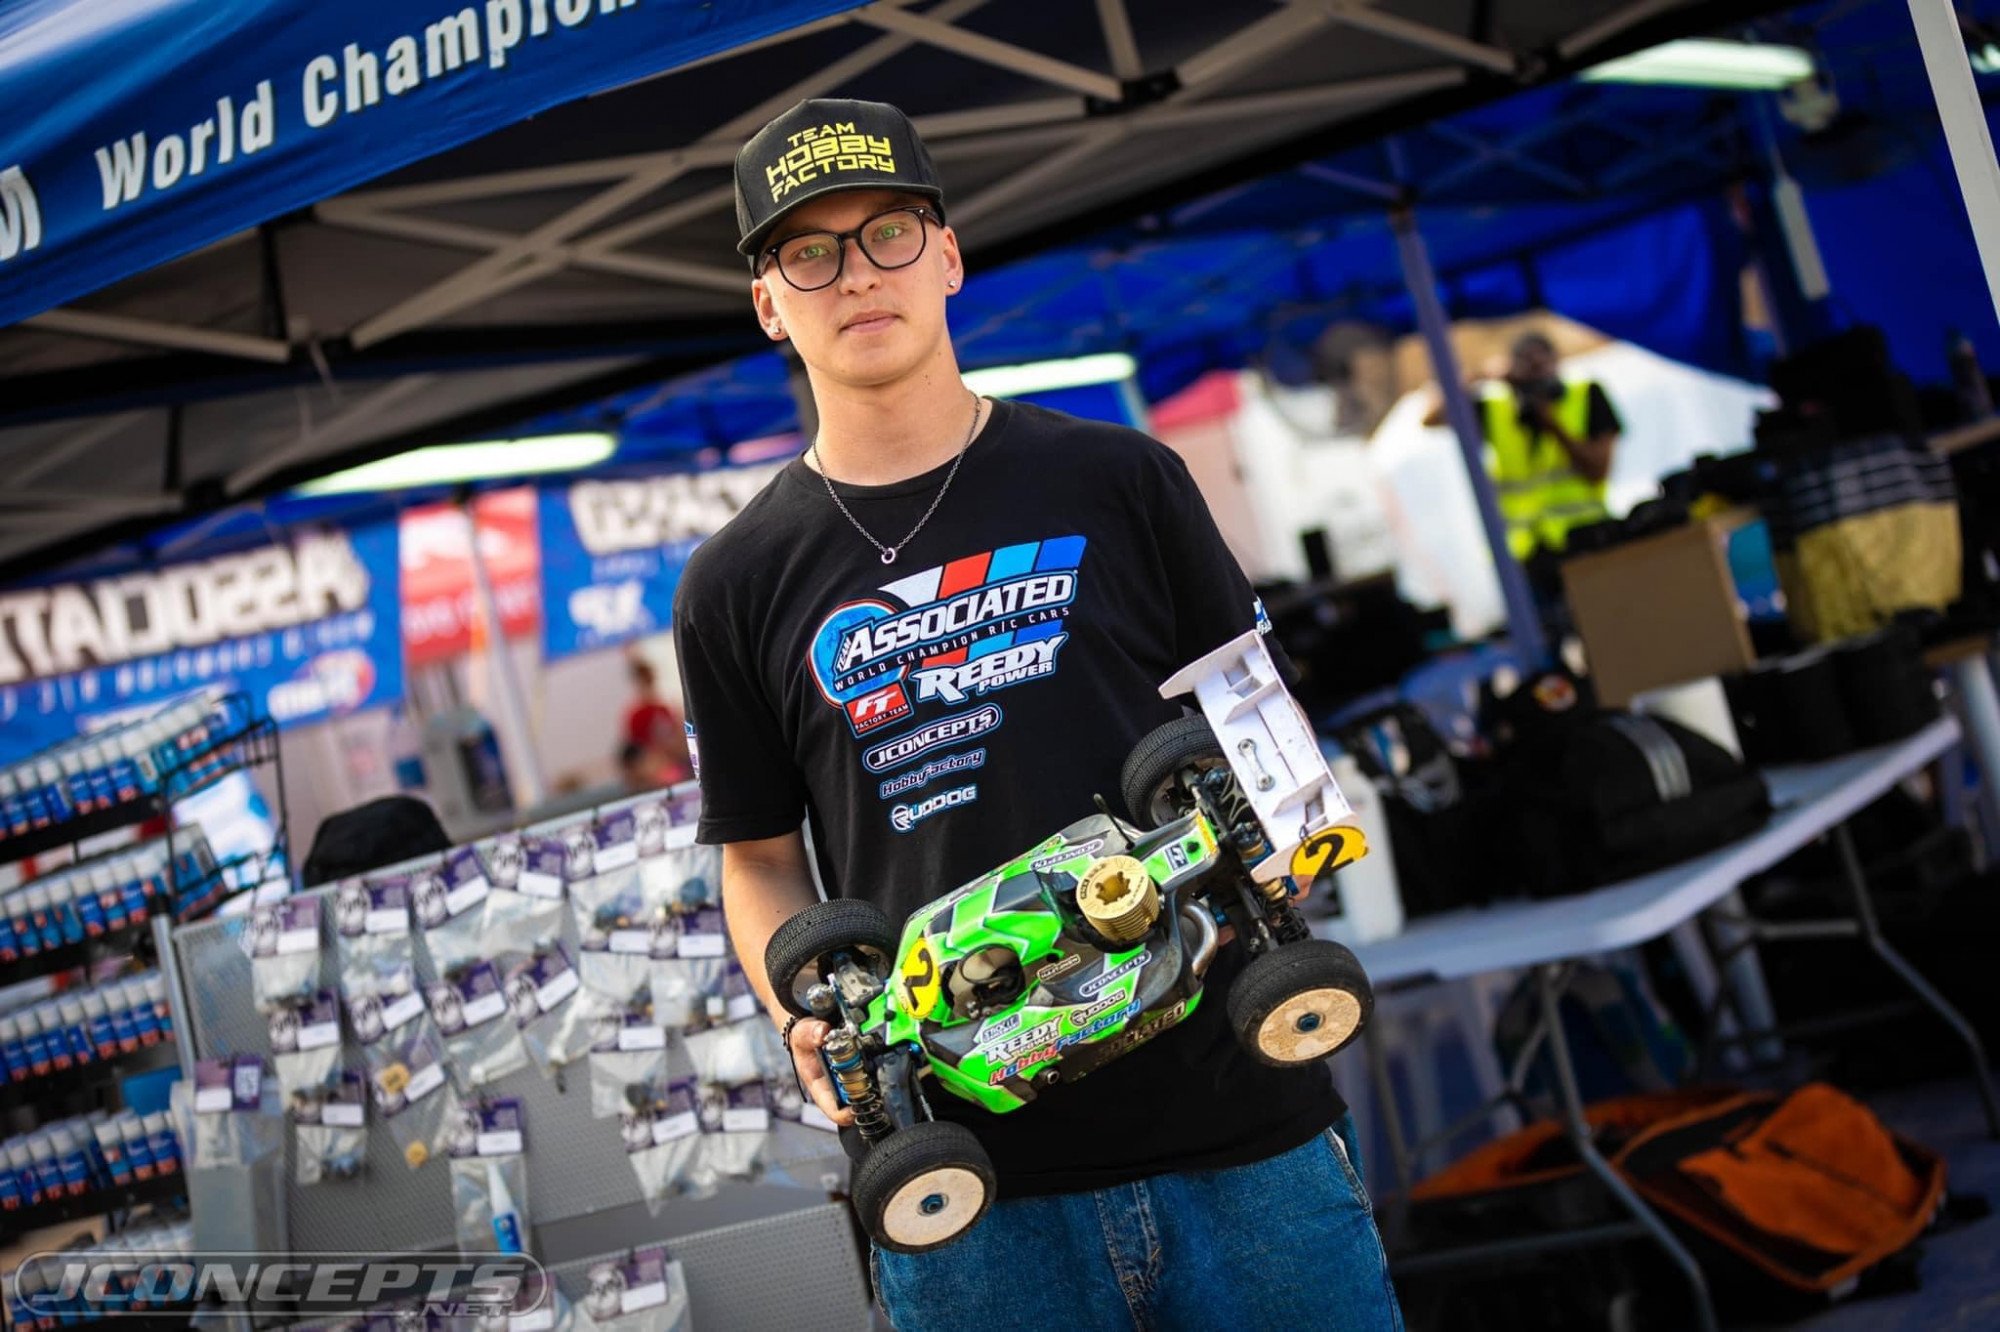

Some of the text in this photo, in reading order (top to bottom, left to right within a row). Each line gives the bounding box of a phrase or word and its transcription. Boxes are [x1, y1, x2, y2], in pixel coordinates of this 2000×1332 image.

[94, 0, 638, 210] World Champio
[765, 134, 892, 187] HOBBY
[787, 122, 855, 147] TEAM
[771, 154, 896, 203] FACTORY
[834, 606, 1071, 691] WORLD CHAMPION R/C CARS
[842, 574, 1073, 672] ASSOCIATED
[912, 634, 1066, 703] REEDY
[978, 660, 1054, 692] POWER
[855, 703, 909, 729] FACTORY TEAM
[873, 709, 992, 767] JCONCEPTS
[1304, 833, 1355, 880] 2
[903, 947, 934, 1011] 2
[1084, 953, 1147, 993] JCONCEPTS
[983, 1012, 1063, 1064] REEDY
